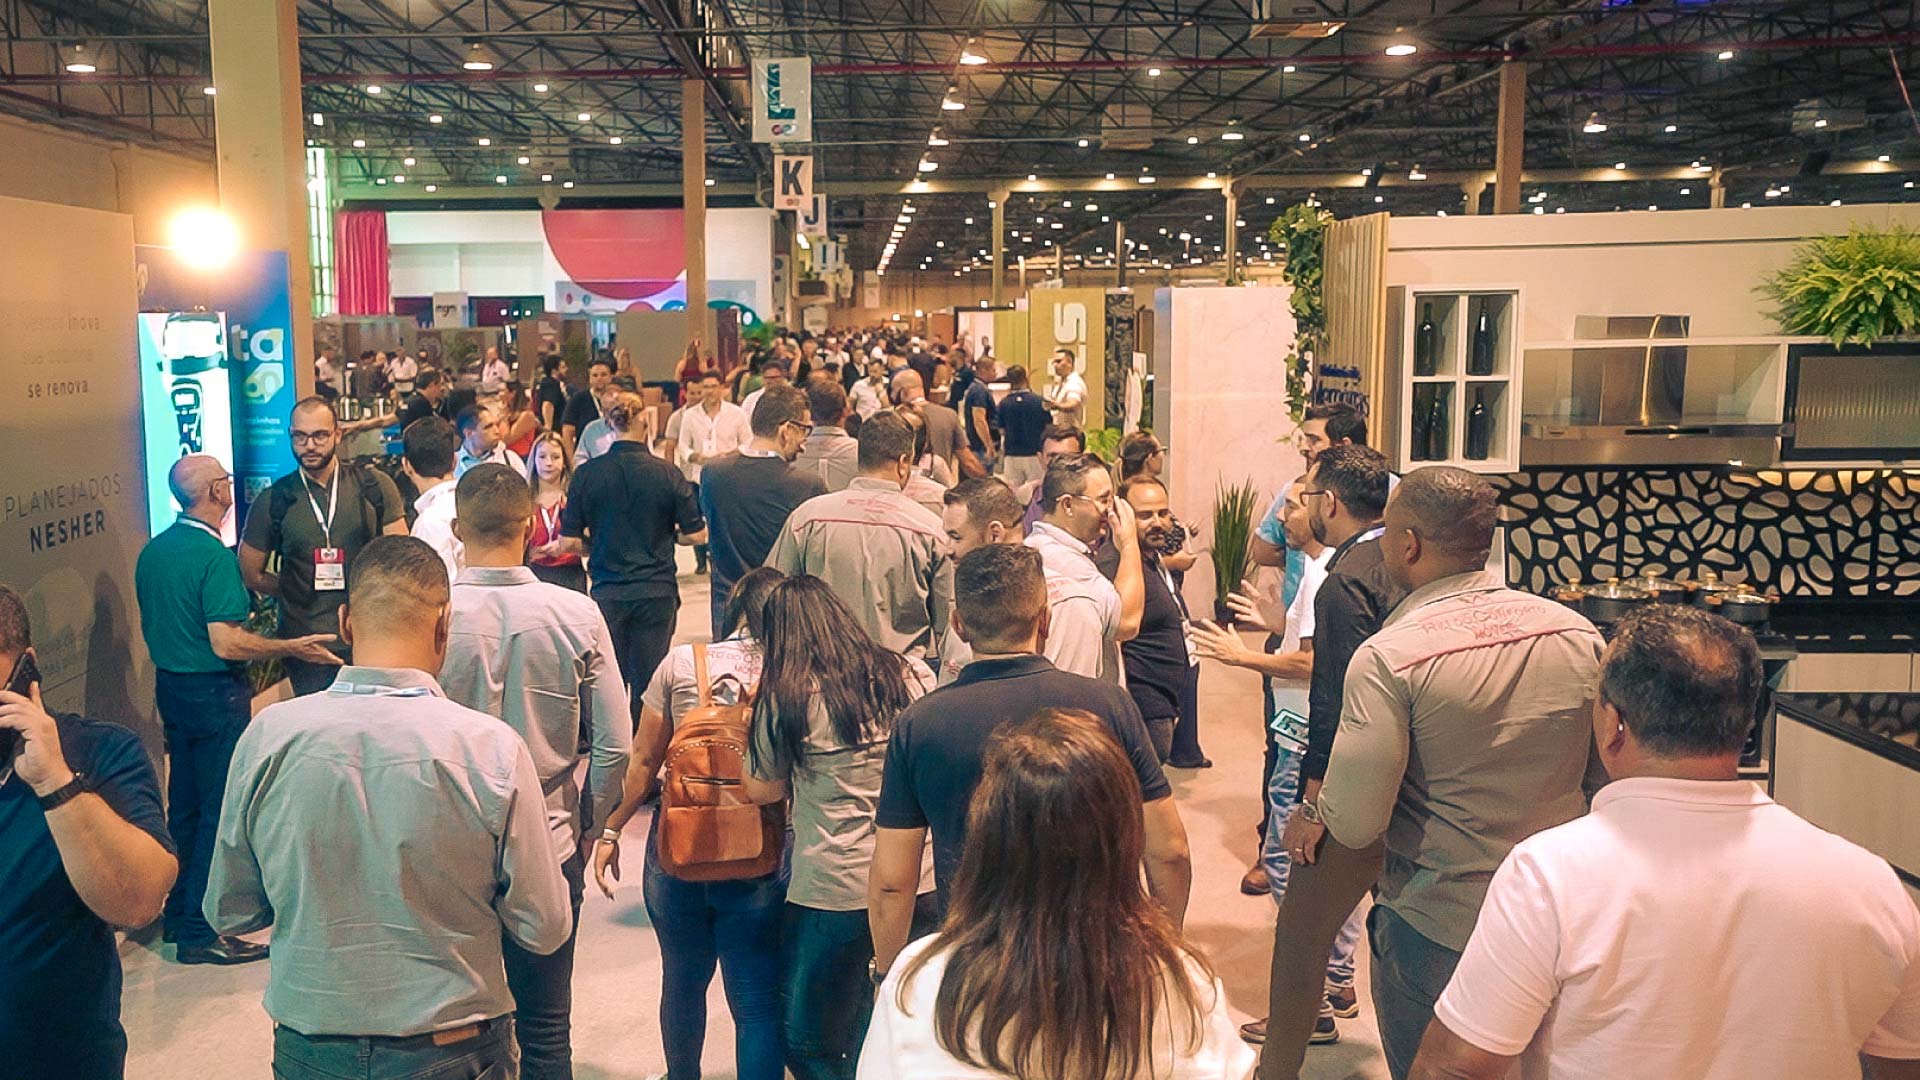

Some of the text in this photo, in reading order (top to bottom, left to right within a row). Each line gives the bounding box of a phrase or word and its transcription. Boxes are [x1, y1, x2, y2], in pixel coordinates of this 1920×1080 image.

[768, 63, 795, 119] L
[781, 160, 803, 195] K
[804, 197, 819, 225] J
[27, 380, 89, 398] se renova
[5, 473, 121, 521] PLANEJADOS
[30, 509, 105, 553] NESHER
